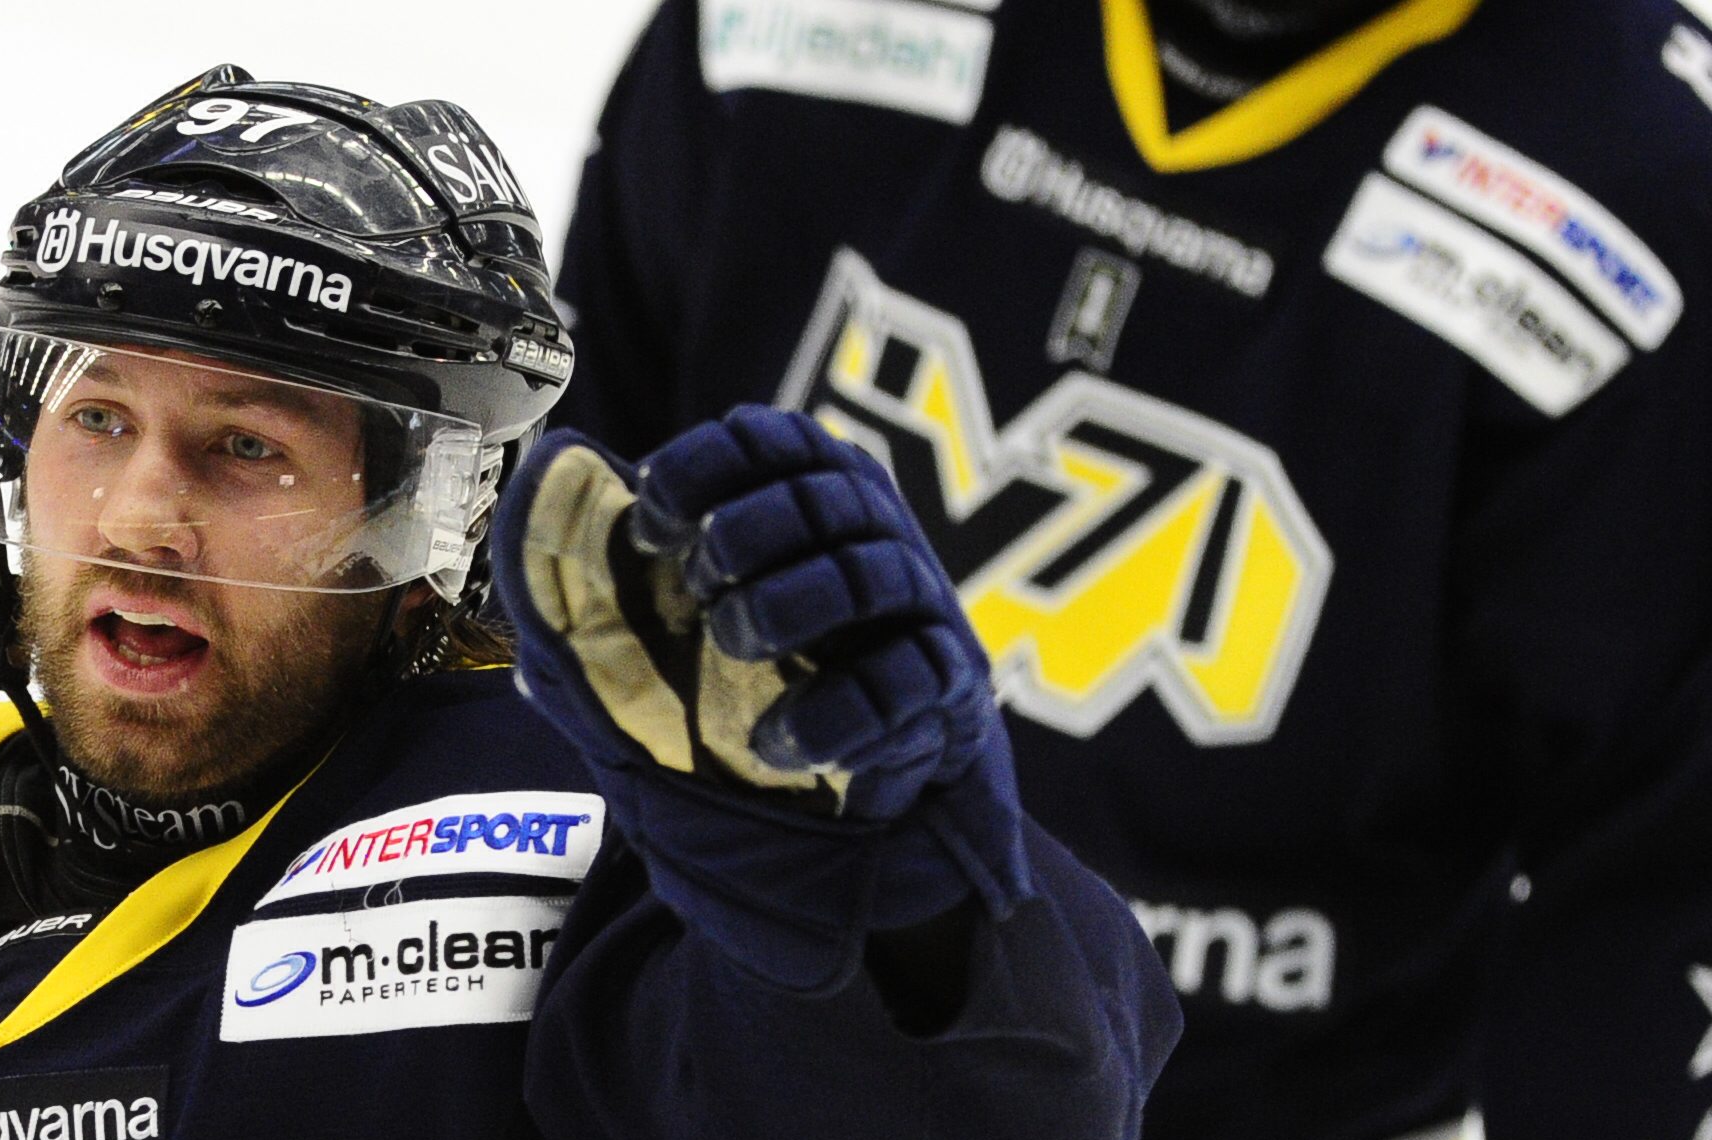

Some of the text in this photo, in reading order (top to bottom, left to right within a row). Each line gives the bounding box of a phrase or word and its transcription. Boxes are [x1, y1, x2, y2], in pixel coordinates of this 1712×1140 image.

[177, 98, 318, 143] 97
[110, 188, 278, 221] BAUER
[77, 216, 354, 314] Husqvarna
[314, 811, 581, 876] INTERSPORT
[319, 974, 485, 1007] PAPERTECH
